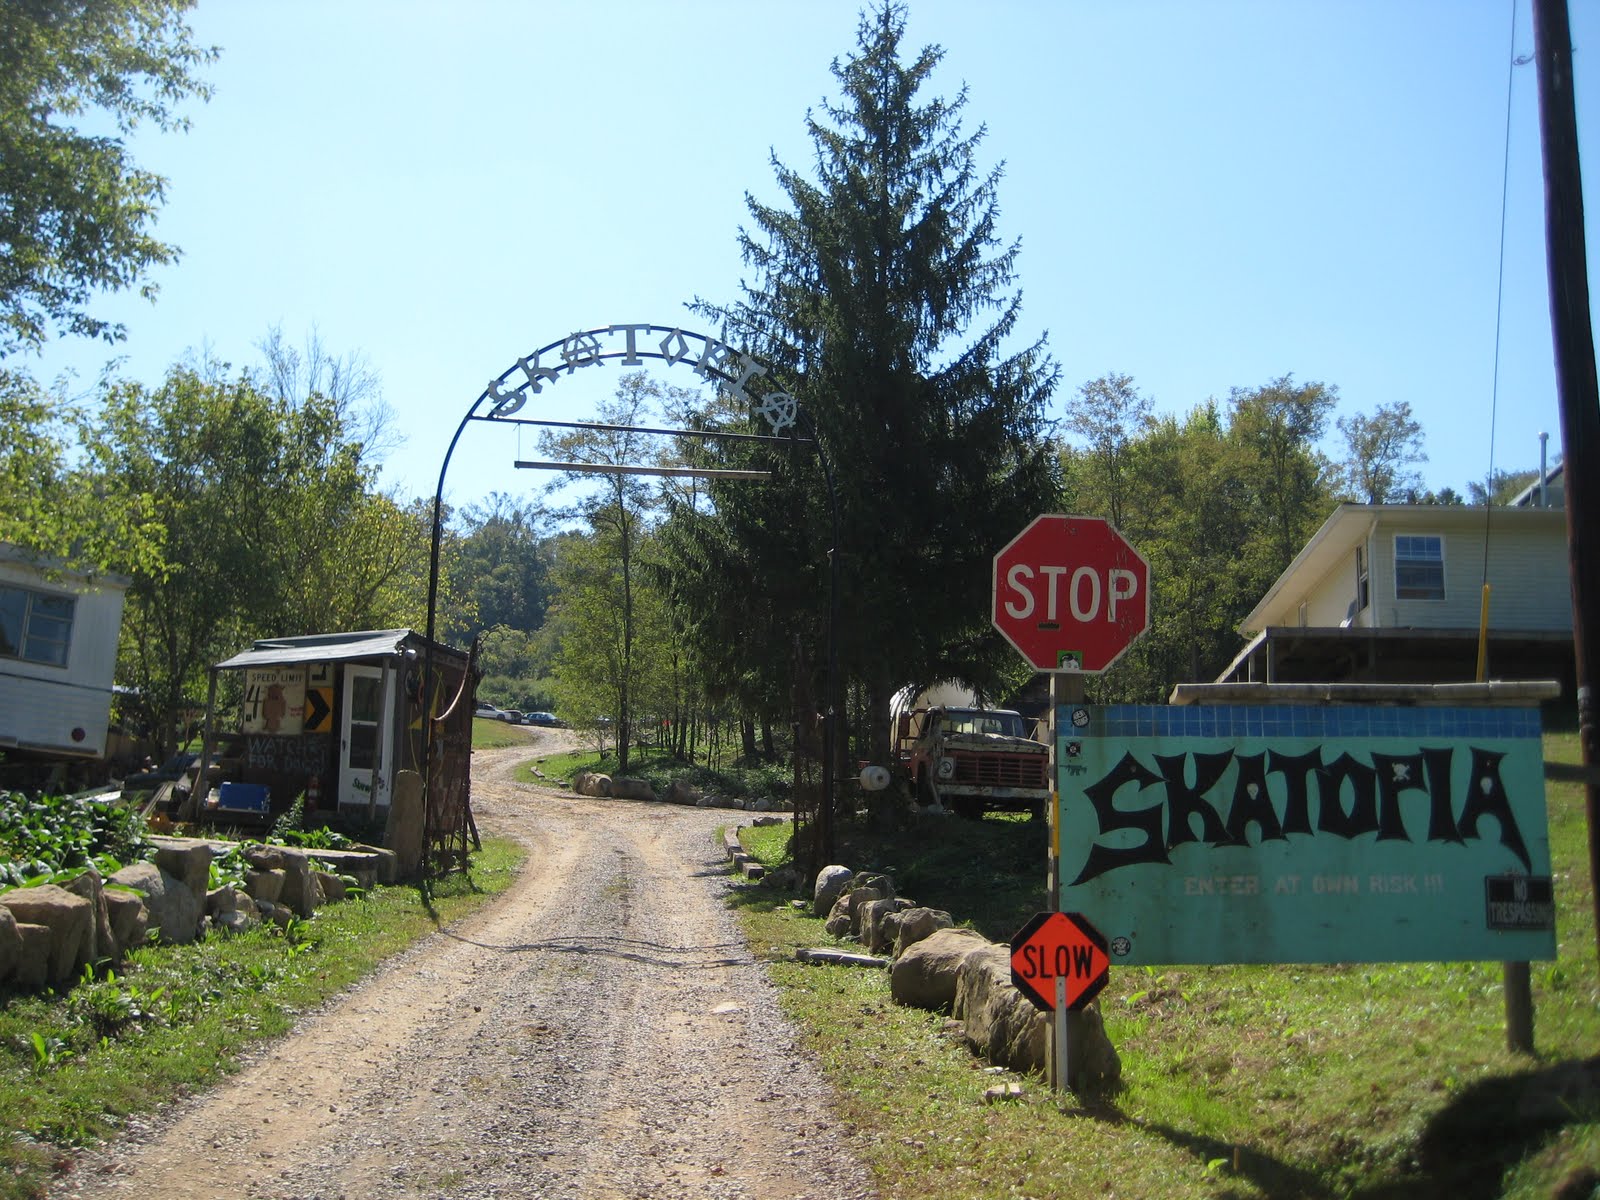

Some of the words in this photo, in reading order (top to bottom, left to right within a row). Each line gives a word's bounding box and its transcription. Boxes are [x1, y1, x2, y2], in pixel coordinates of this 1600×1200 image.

[488, 323, 798, 437] SKATOPIA
[1004, 563, 1138, 622] STOP
[252, 672, 277, 682] SPEED
[281, 673, 303, 682] LIMIT
[1067, 745, 1532, 886] SKATOPIA
[1184, 875, 1259, 896] ENTER
[1274, 875, 1301, 895] AT
[1312, 874, 1359, 895] OWN
[1369, 873, 1417, 894] RISK
[1513, 878, 1528, 902] NO
[1022, 945, 1093, 979] SLOW
